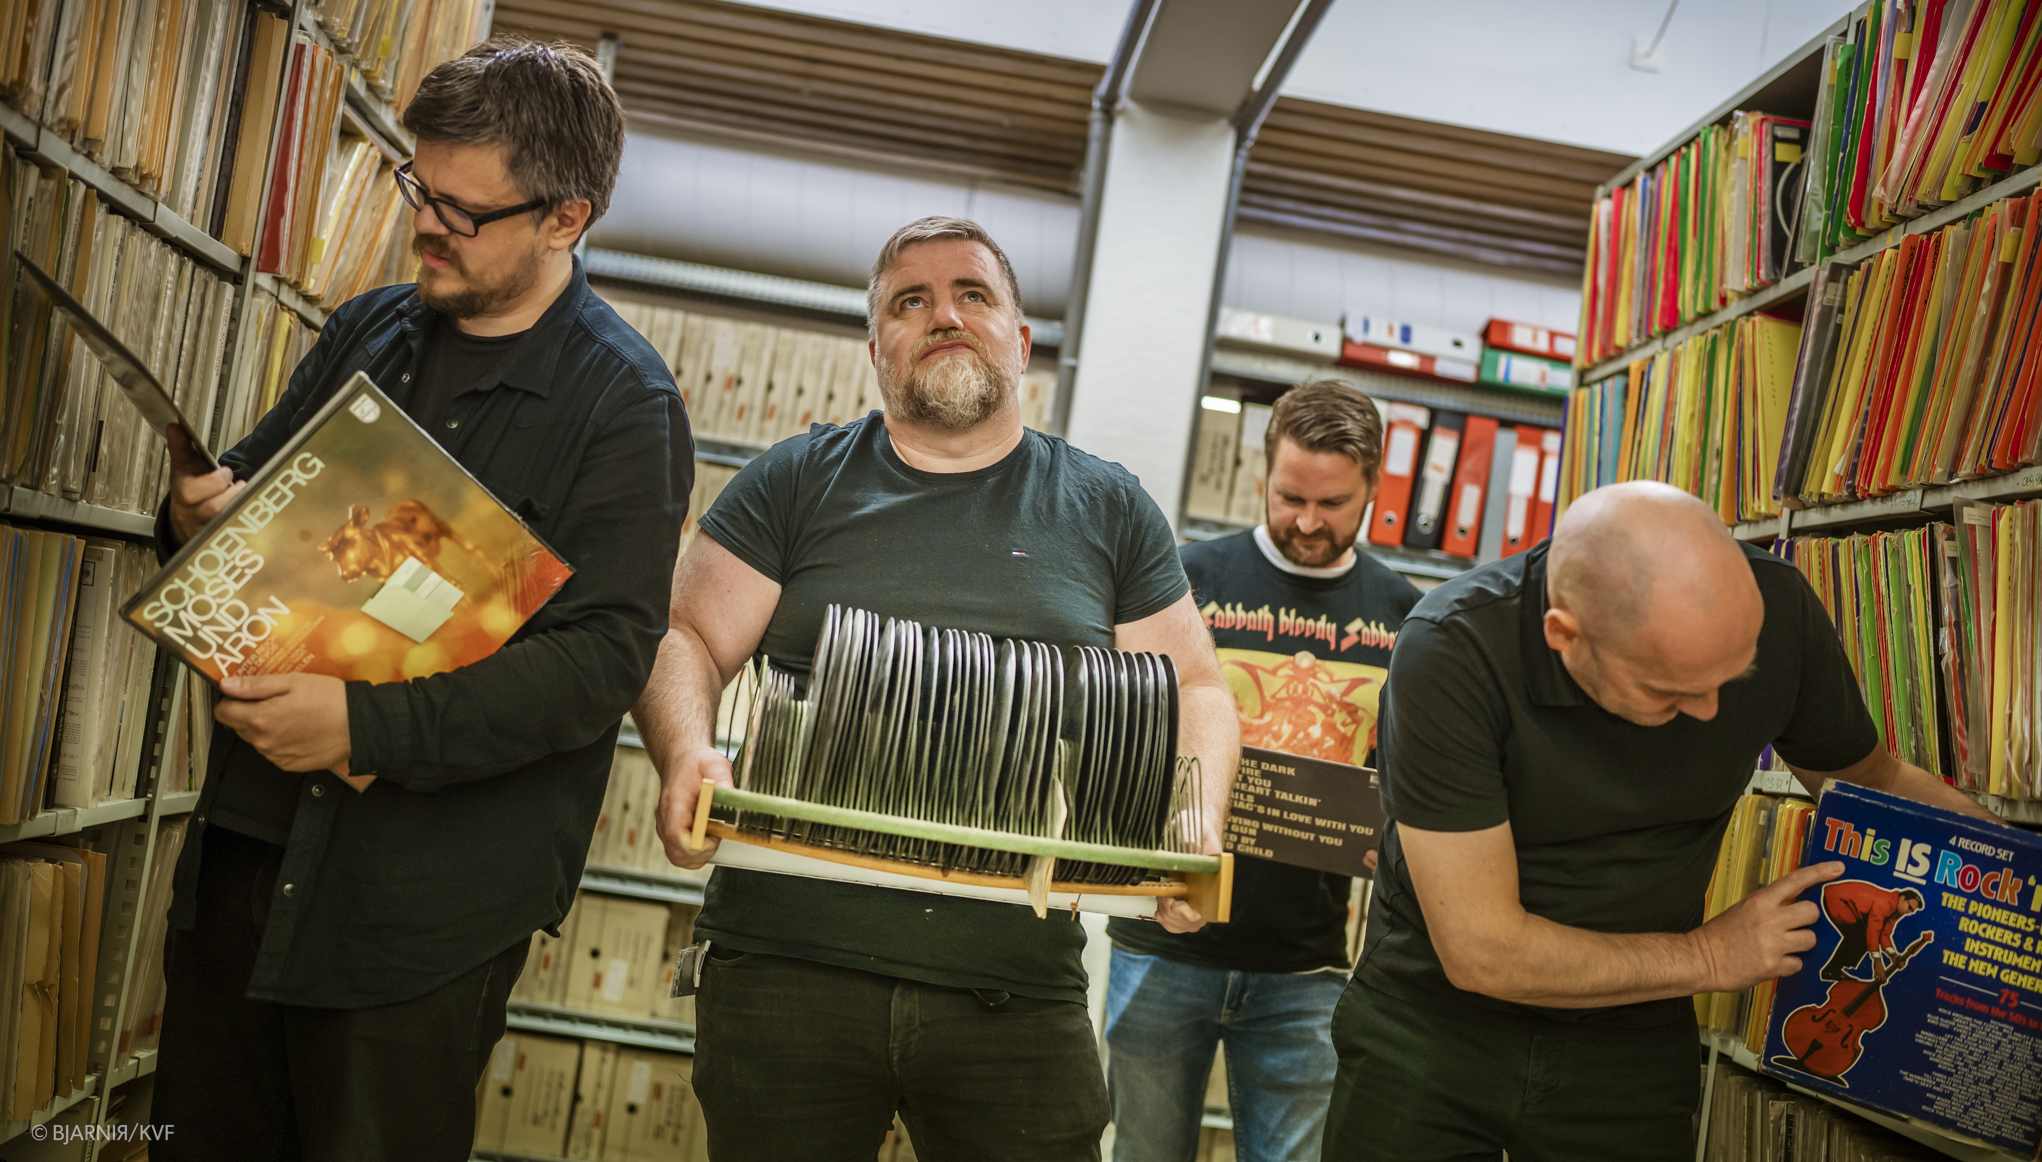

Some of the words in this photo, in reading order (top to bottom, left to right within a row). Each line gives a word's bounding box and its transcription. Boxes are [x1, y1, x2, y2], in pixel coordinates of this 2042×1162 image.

[143, 451, 326, 629] SCHOENBERG
[162, 548, 265, 646] MOSES
[184, 600, 250, 661] UND
[213, 595, 291, 678] ARON
[1278, 606, 1337, 652] bloody
[1239, 767, 1262, 778] IRE
[1240, 758, 1258, 768] HE
[1260, 762, 1296, 776] DARK
[1248, 775, 1272, 788] YOU
[1274, 790, 1322, 807] TALKIN'
[1262, 822, 1316, 842] WITHOUT
[1318, 834, 1344, 846] YOU
[1266, 806, 1280, 818] IN
[1282, 810, 1312, 824] LOVE
[1314, 818, 1346, 831] WITH
[1349, 824, 1374, 836] YOU
[1236, 845, 1274, 858] CHILD
[1240, 836, 1257, 846] BY
[1948, 834, 1957, 847] 4
[1957, 836, 1996, 857] RECORD
[1995, 847, 2014, 863] SET
[1824, 816, 1892, 866] This
[1894, 837, 1932, 879] IS
[1934, 849, 2023, 906] Rock
[1940, 891, 1968, 912] THE
[1958, 916, 2022, 949] ROCKERS
[2022, 936, 2034, 952] &
[1942, 948, 1968, 970] THE
[1968, 957, 1999, 980] NEW
[1964, 937, 2042, 975] INSTRUMEN
[1935, 988, 1965, 1006] Tracks
[1965, 997, 1990, 1014] from
[1990, 1004, 2008, 1020] the
[2028, 1017, 2039, 1028] to
[1998, 988, 2020, 1008] 75
